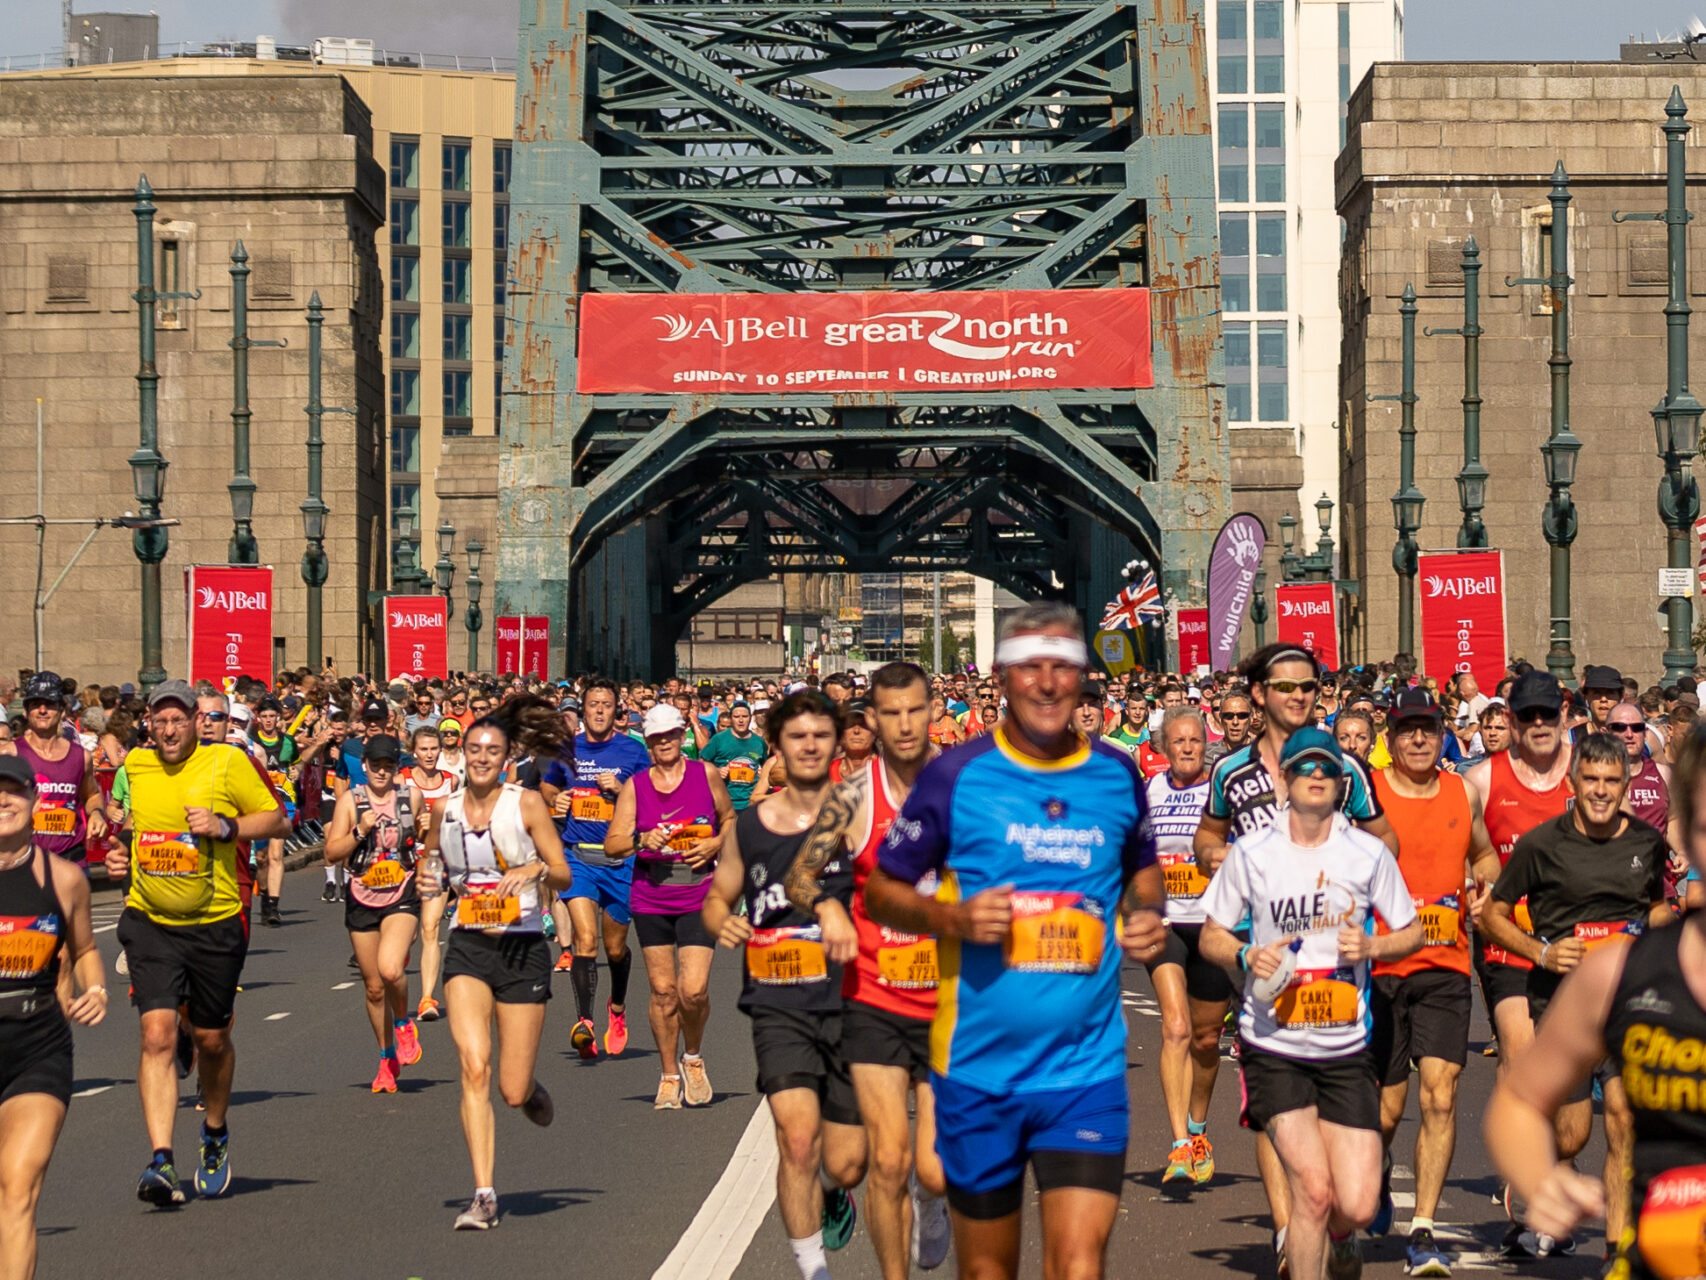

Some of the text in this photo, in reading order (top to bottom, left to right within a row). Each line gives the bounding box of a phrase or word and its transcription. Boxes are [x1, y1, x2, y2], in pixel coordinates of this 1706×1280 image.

[824, 312, 1068, 346] great north
[1011, 340, 1075, 358] run
[673, 370, 748, 383] SUNDAY
[756, 374, 779, 385] 10
[785, 369, 889, 385] SEPTEMBER
[913, 367, 1057, 384] GREATRUN.ORG
[1218, 569, 1253, 651] WellChild
[226, 633, 243, 670] Feel
[1457, 619, 1474, 657] Feel
[413, 644, 425, 671] Feel
[1634, 789, 1660, 800] FELL
[1005, 822, 1106, 847] Alzheimer's
[1022, 839, 1092, 869] Society
[1270, 892, 1325, 923] VALE
[1280, 917, 1311, 933] YORK
